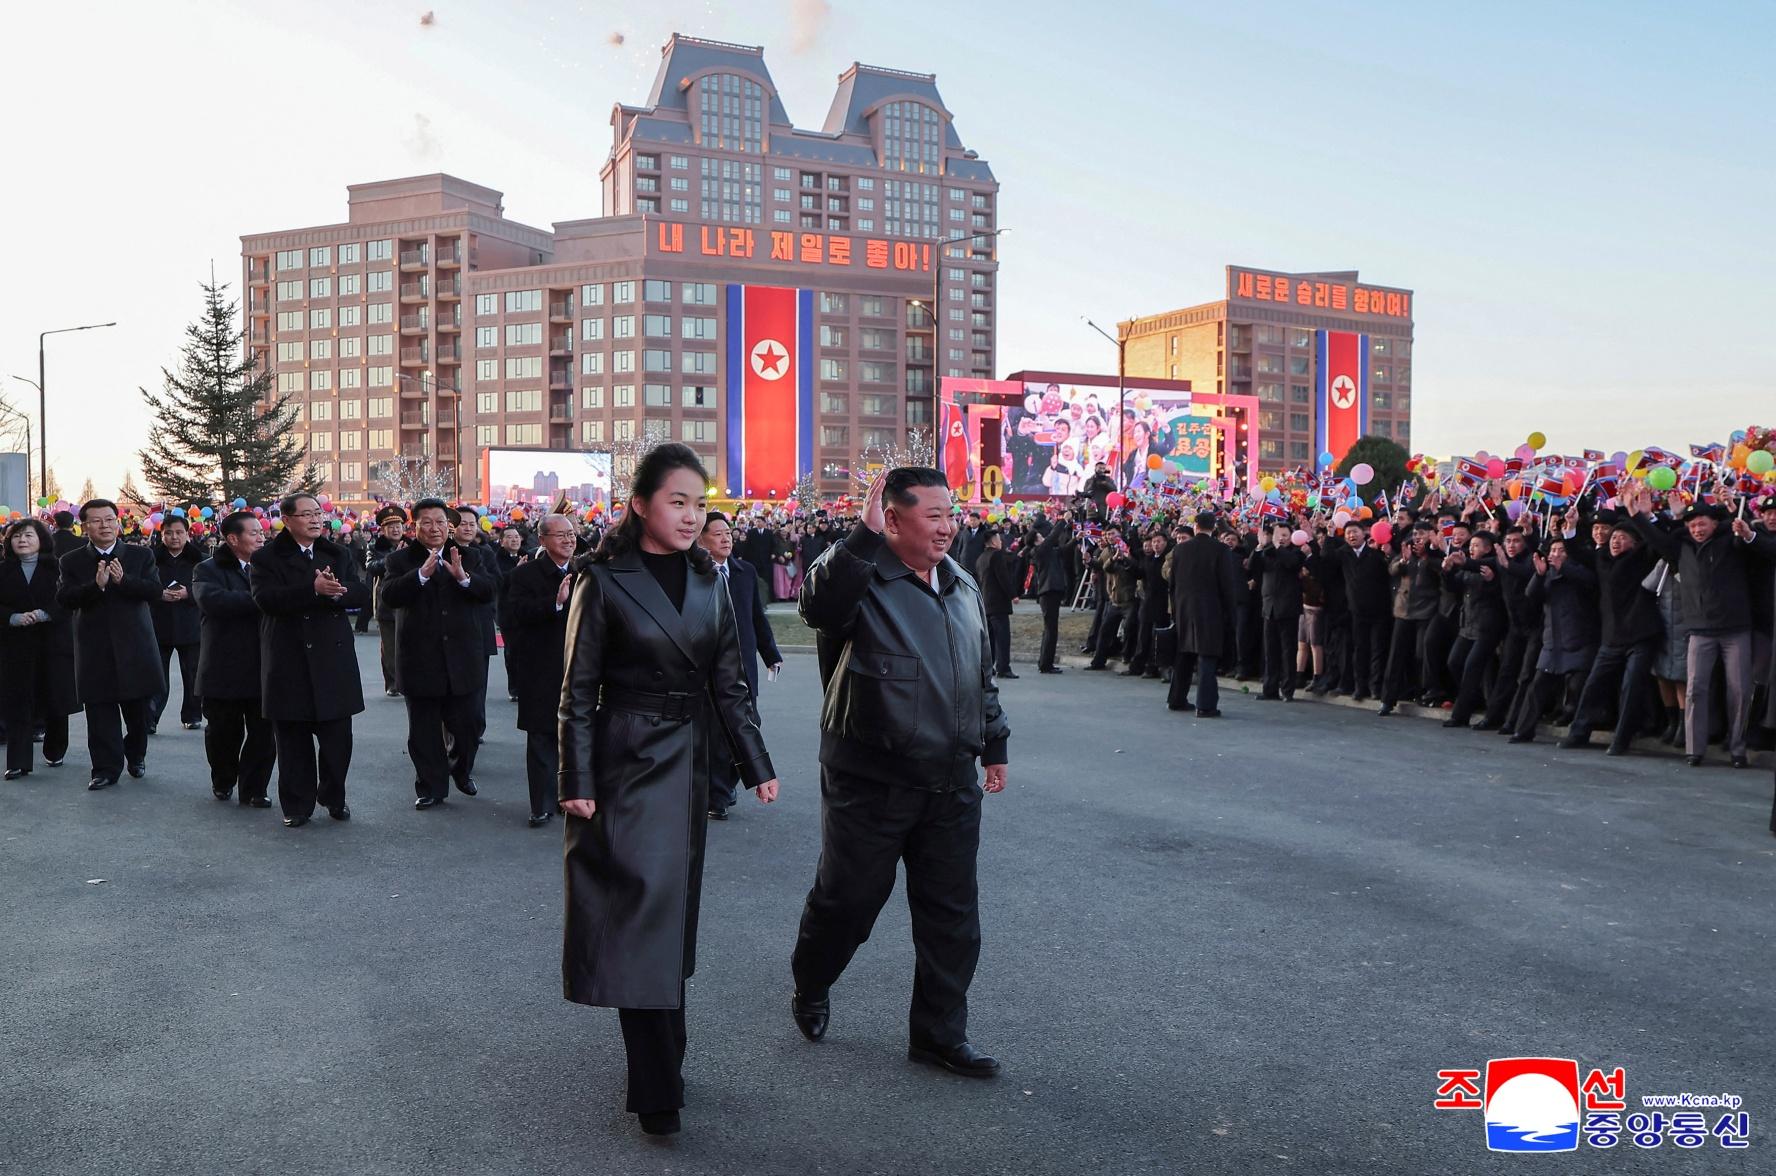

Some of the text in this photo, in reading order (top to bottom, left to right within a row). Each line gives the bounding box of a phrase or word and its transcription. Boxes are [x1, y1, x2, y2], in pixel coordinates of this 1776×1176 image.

[659, 222, 930, 271] 내 나라 제일로 좋아!
[1237, 271, 1409, 317] 새로운 승리를 향하여!
